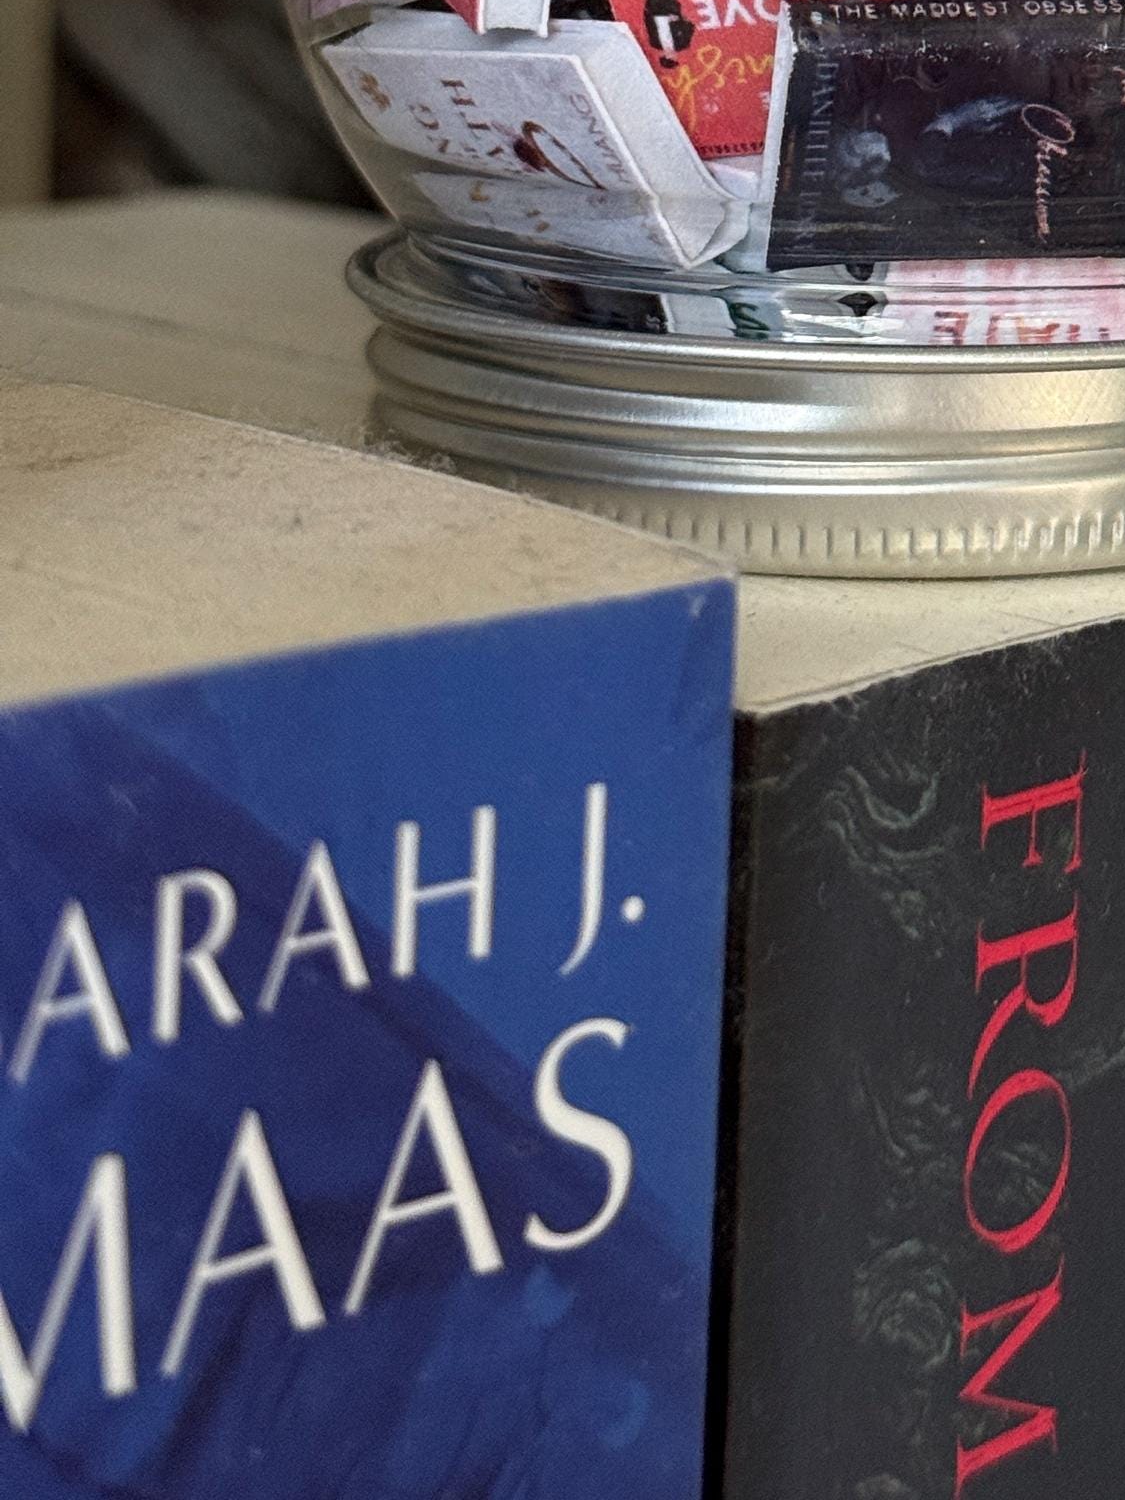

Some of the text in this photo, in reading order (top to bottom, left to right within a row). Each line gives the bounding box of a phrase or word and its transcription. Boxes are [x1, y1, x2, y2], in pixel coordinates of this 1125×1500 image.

[829, 2, 879, 21] THE
[891, 0, 1009, 19] MADDEST
[560, 782, 645, 976] J.
[0, 1018, 636, 1435] MAAS
[954, 748, 1089, 1499] FROM
